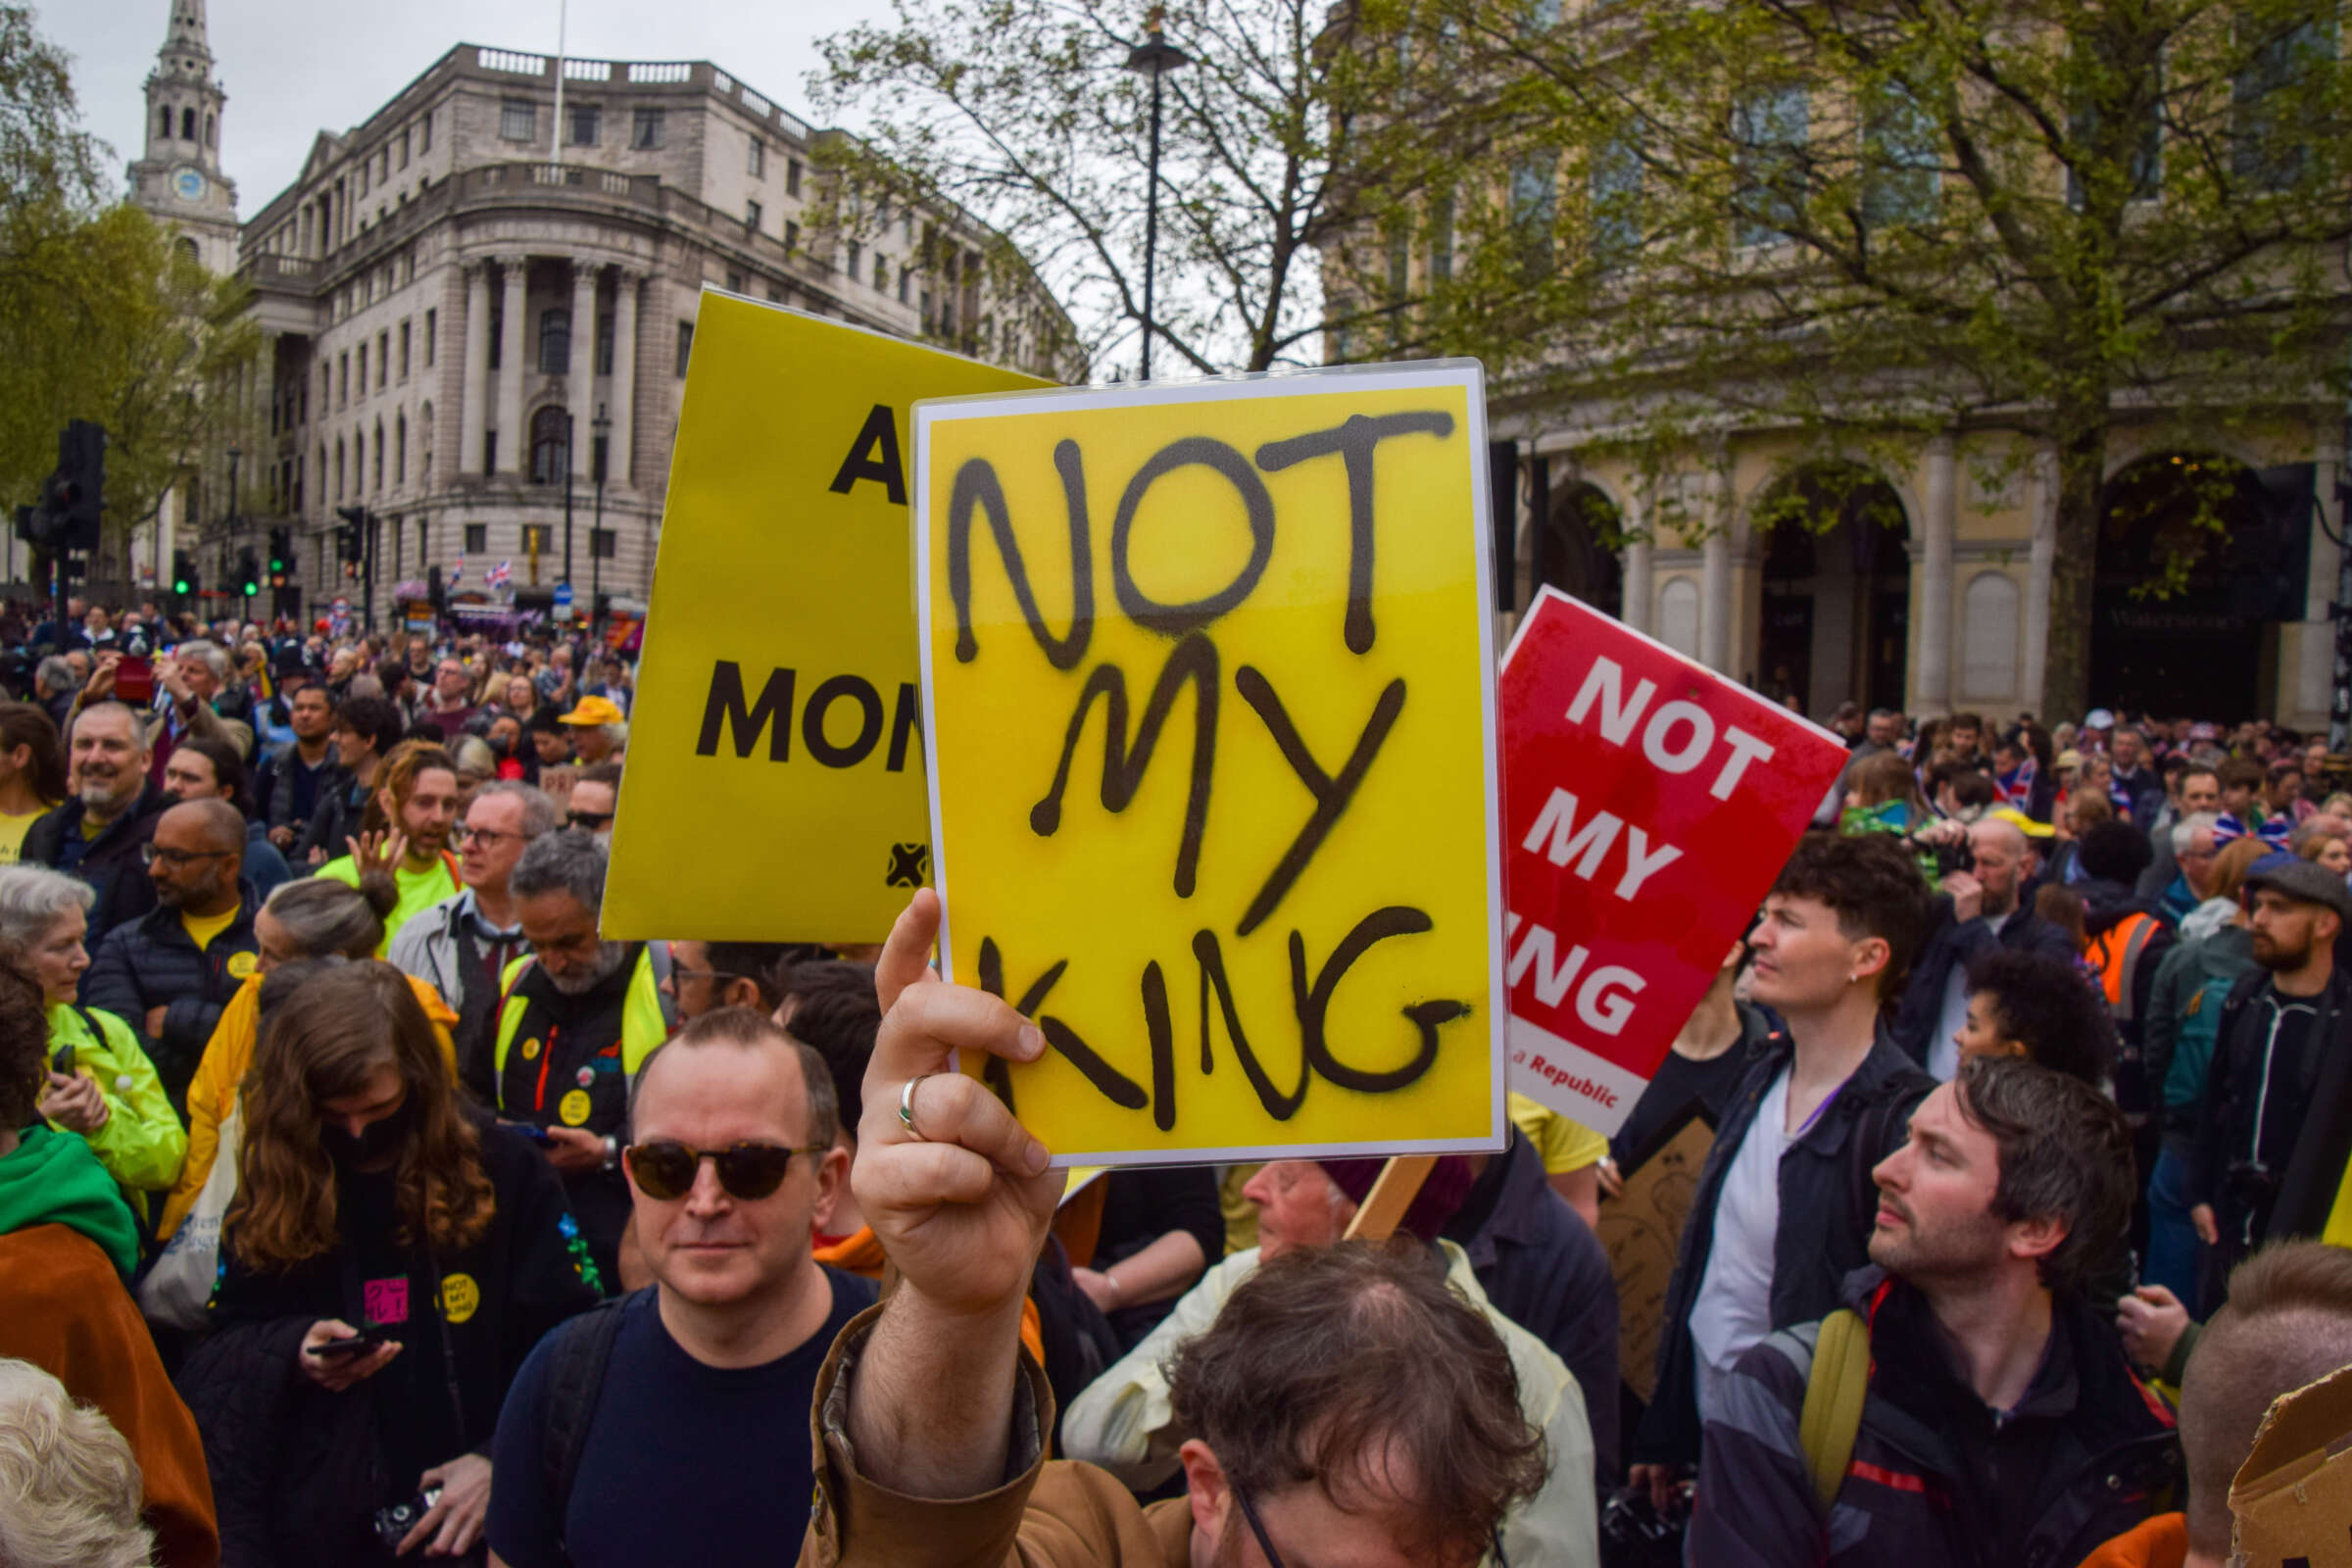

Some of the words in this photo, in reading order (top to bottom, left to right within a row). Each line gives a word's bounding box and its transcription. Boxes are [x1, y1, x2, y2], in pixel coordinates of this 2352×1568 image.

[948, 410, 1456, 670] NOT
[1030, 631, 1406, 937] MY
[1565, 655, 1775, 802] NOT
[1522, 786, 1684, 902] MY
[978, 905, 1473, 1131] KING
[1513, 1050, 1526, 1064] a
[1530, 1054, 1619, 1109] Republic
